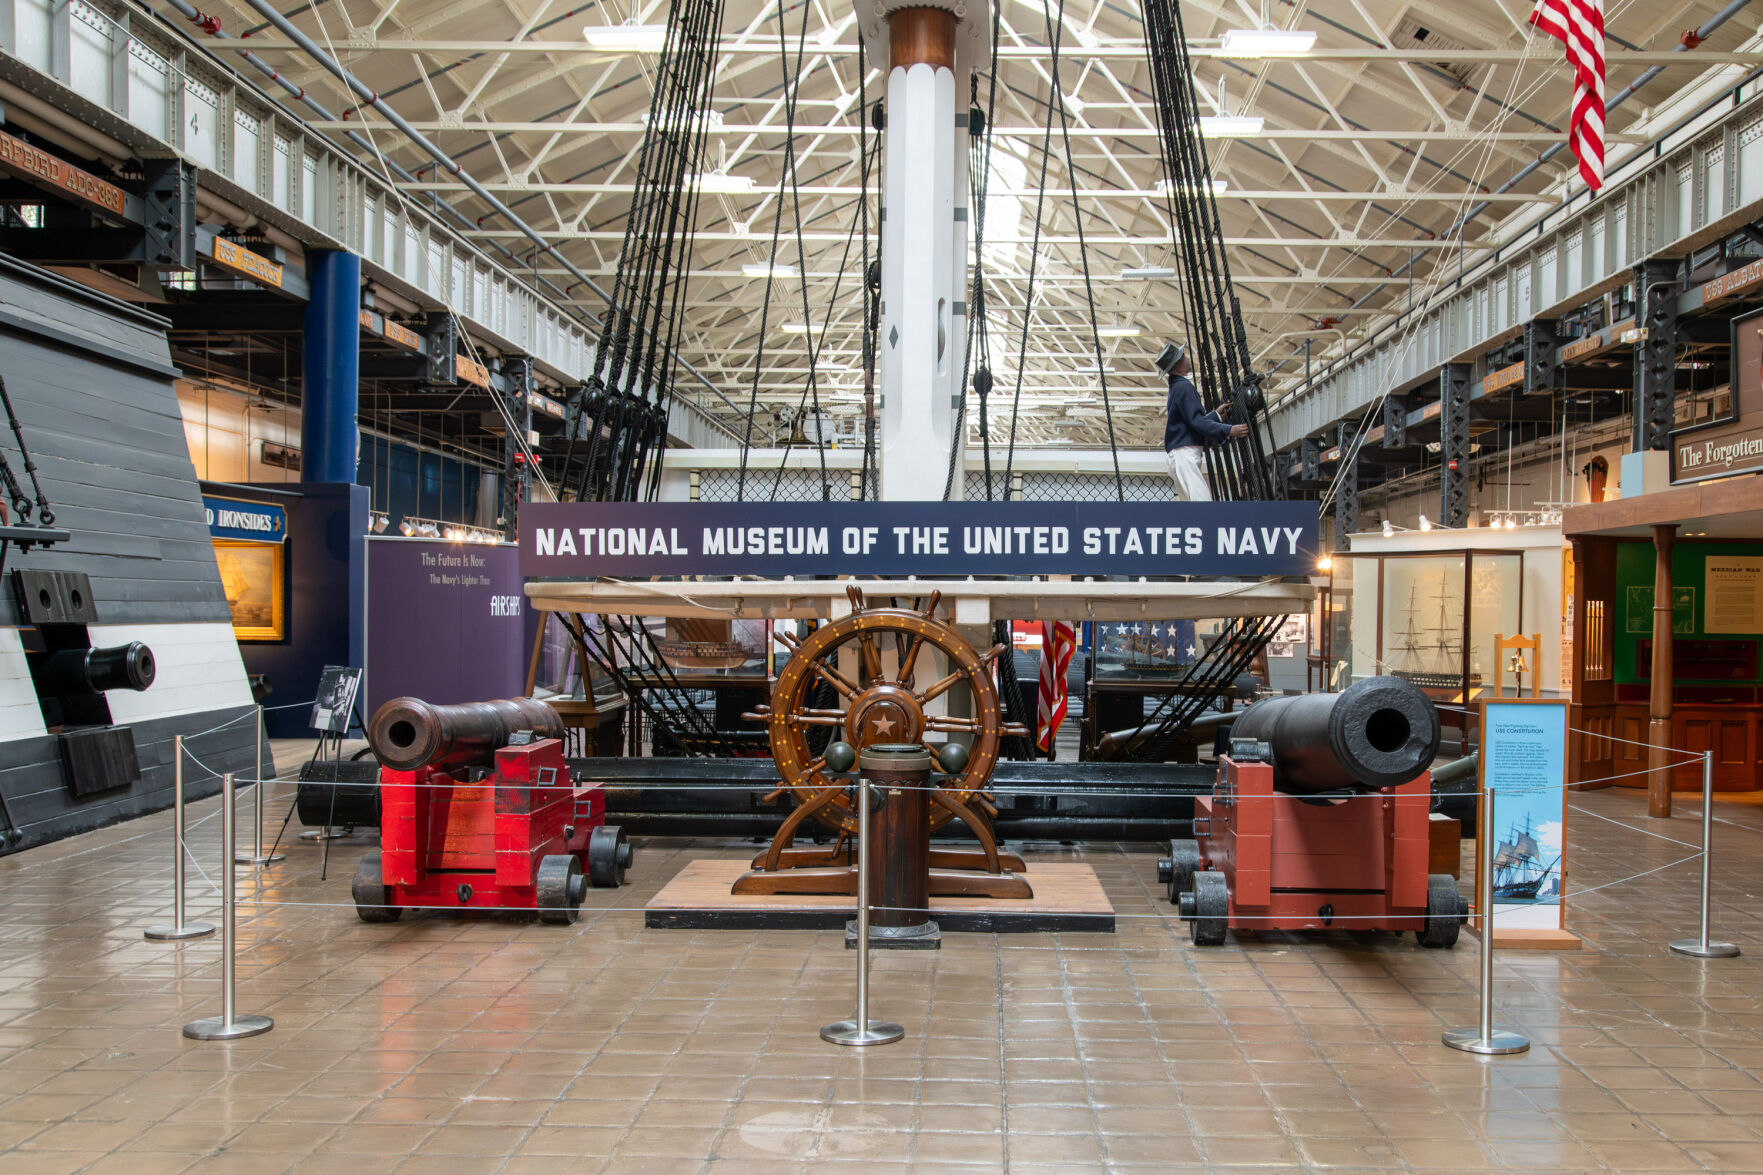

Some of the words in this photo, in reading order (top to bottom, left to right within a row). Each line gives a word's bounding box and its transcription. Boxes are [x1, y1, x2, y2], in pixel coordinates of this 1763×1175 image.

[0, 134, 60, 181] RFBIRD
[219, 240, 237, 263] USS
[1705, 279, 1723, 299] USS
[1727, 260, 1763, 291] ALBAT
[1680, 446, 1703, 468] The
[1705, 438, 1763, 467] Forgotten
[218, 510, 272, 531] IRONSIDES
[536, 528, 688, 556] NATIONAL
[702, 527, 829, 555] MUSEUM
[842, 527, 879, 555] OF
[893, 527, 949, 555] THE
[963, 526, 1069, 554] UNITED
[1083, 527, 1202, 555] STATES
[1217, 527, 1303, 555] NAVY
[421, 552, 436, 566] The
[438, 553, 461, 567] Future
[463, 554, 468, 567] Is
[429, 573, 441, 585] The
